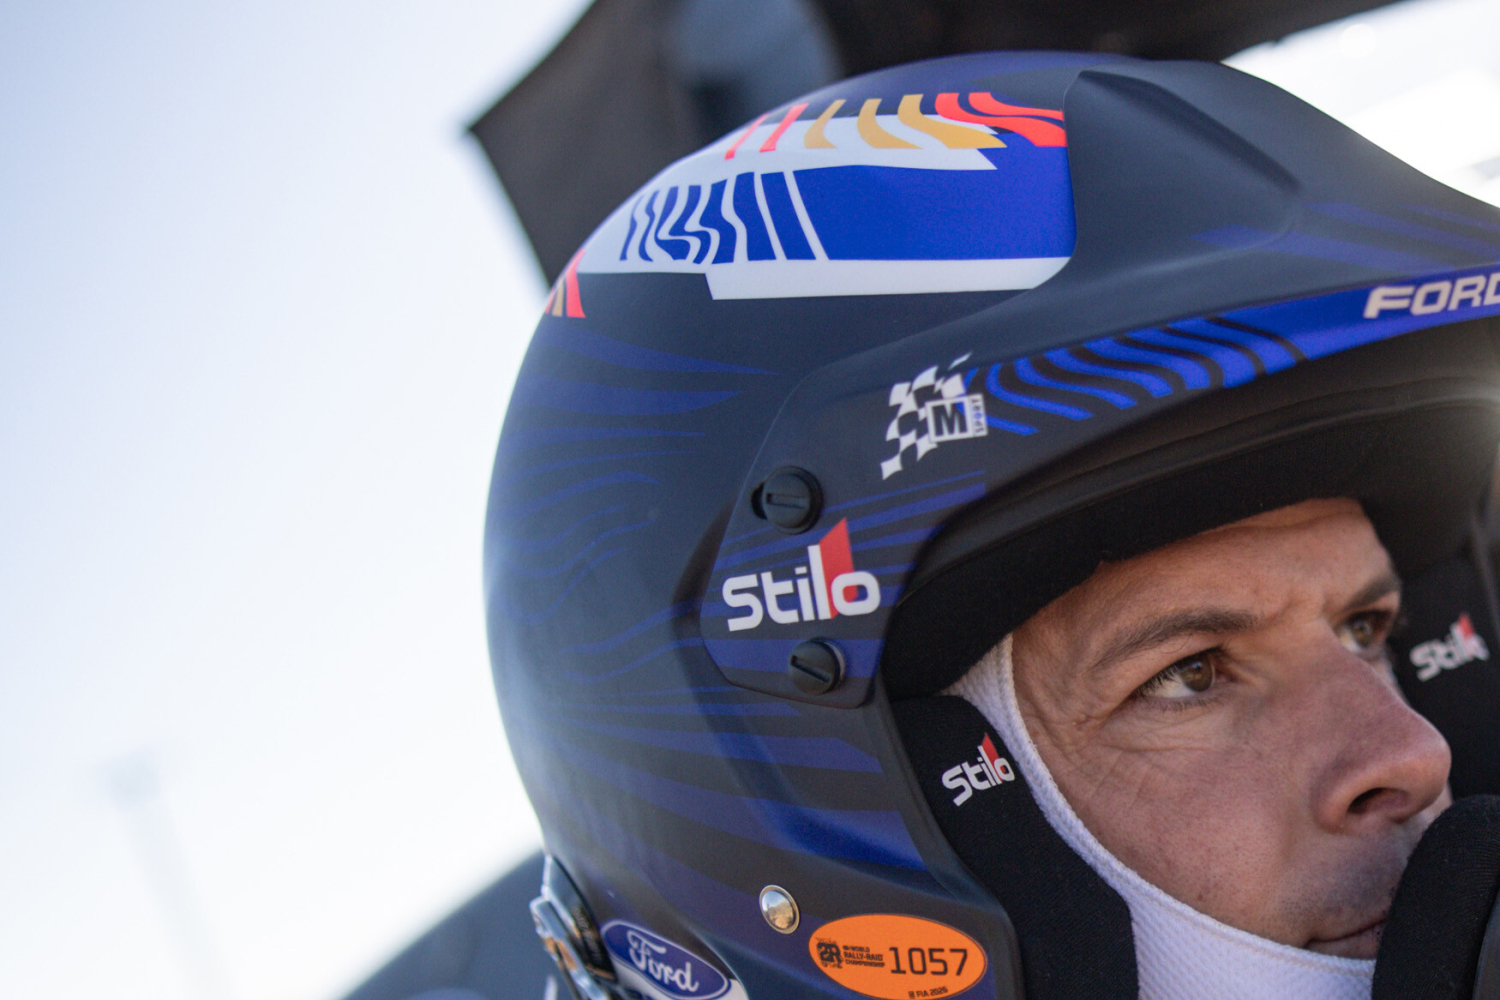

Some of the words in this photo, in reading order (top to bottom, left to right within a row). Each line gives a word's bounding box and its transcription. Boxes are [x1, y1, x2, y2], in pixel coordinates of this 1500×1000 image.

[932, 401, 968, 437] M
[722, 517, 881, 632] Stilo
[941, 733, 1015, 806] Stilo
[627, 930, 699, 992] Ford
[889, 946, 968, 976] 1057
[930, 986, 948, 997] 2026
